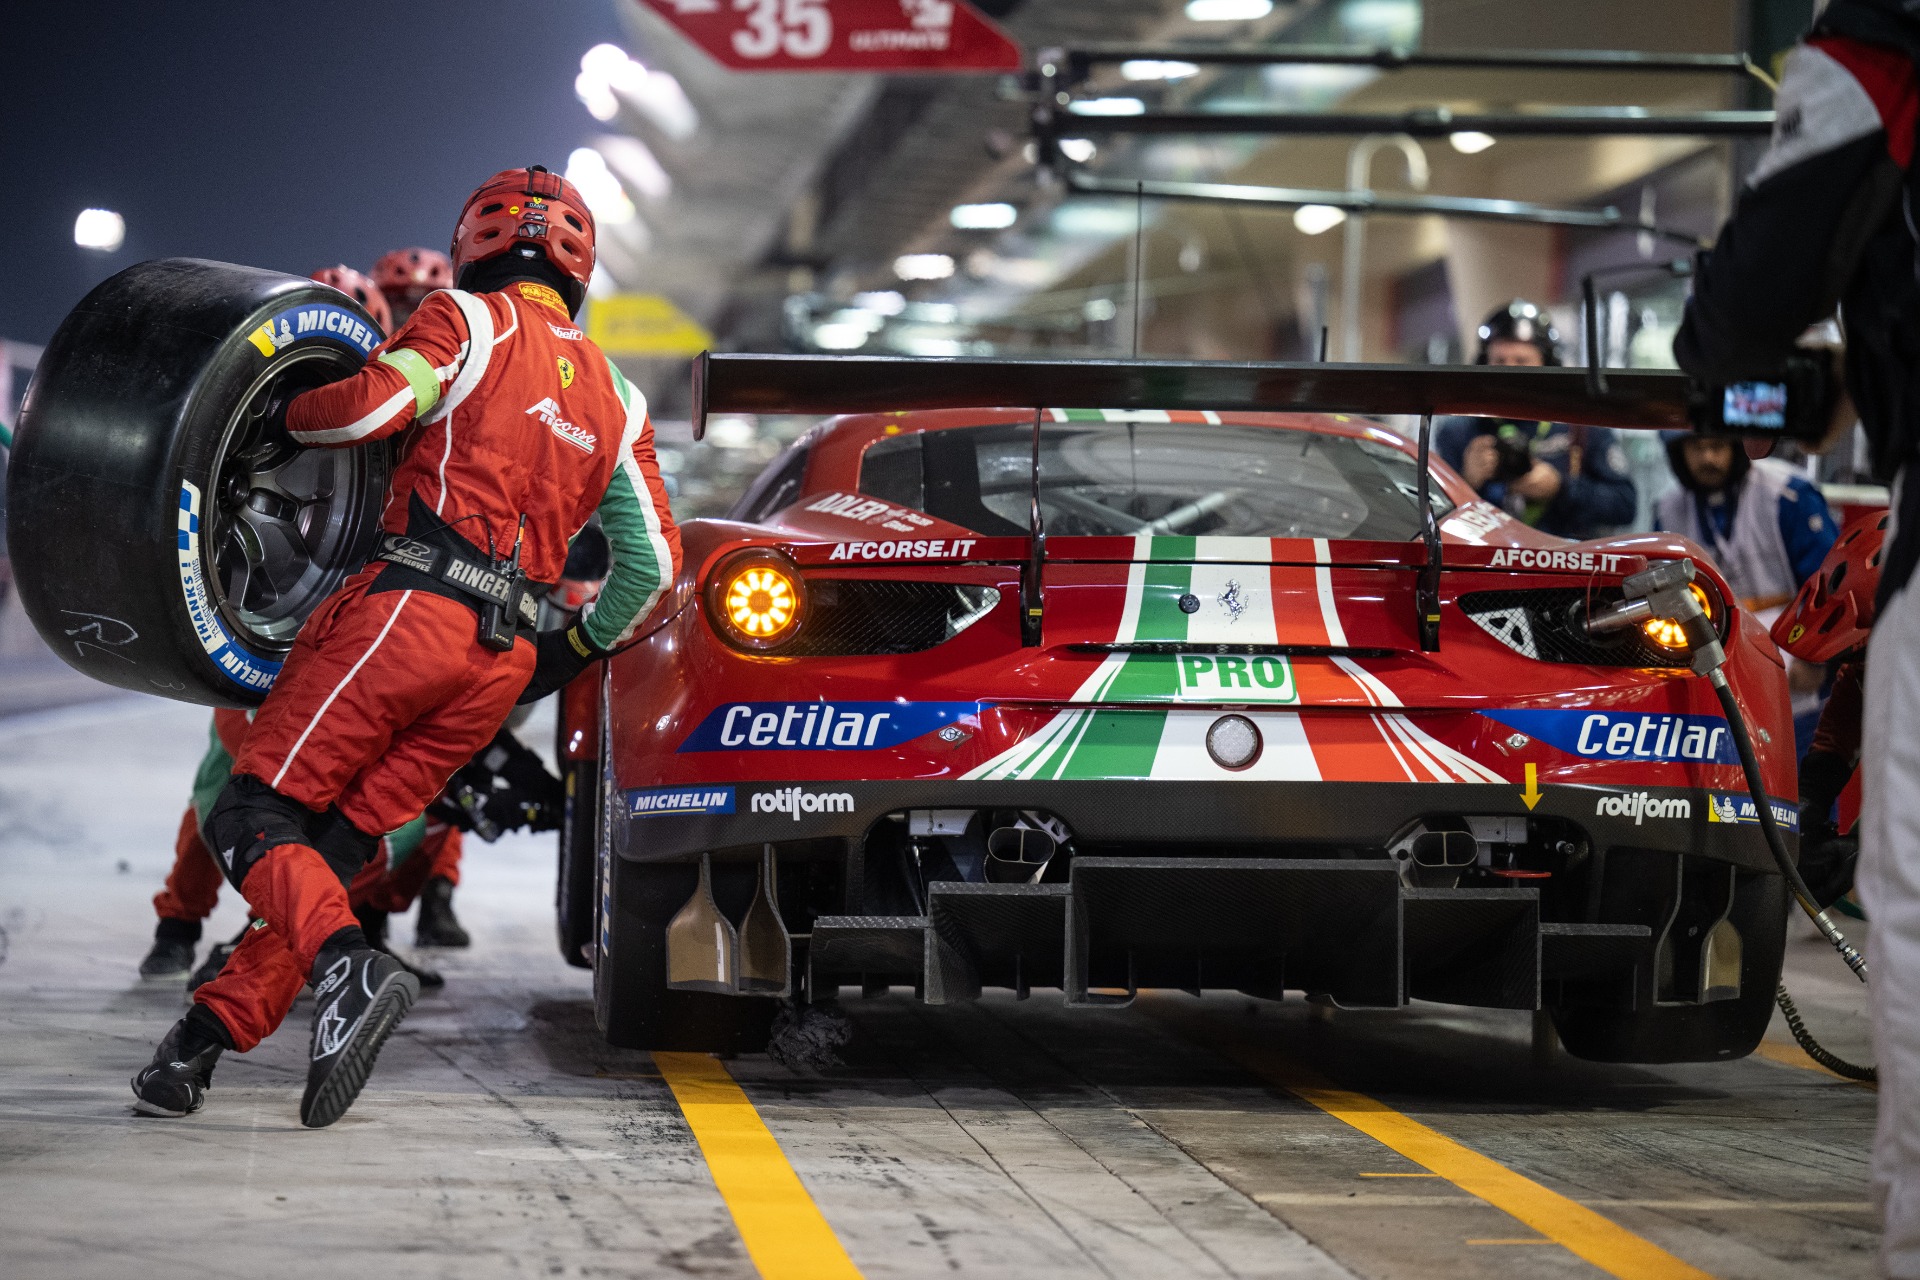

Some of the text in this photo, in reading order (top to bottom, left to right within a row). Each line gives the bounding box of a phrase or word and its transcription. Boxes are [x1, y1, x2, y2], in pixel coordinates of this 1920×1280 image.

[731, 0, 833, 60] 35
[297, 310, 387, 357] MICHEL
[804, 492, 889, 521] ADLER
[829, 540, 976, 560] AFCORSE.IT
[1490, 549, 1620, 572] AFCORSE.IT
[183, 576, 212, 643] THANKS
[1181, 655, 1285, 688] PRO
[720, 705, 891, 746] Cetilar
[1577, 714, 1725, 759] Cetilar
[635, 792, 728, 810] MICHELIN
[751, 787, 855, 821] rotiform
[1596, 792, 1691, 825] rotiform
